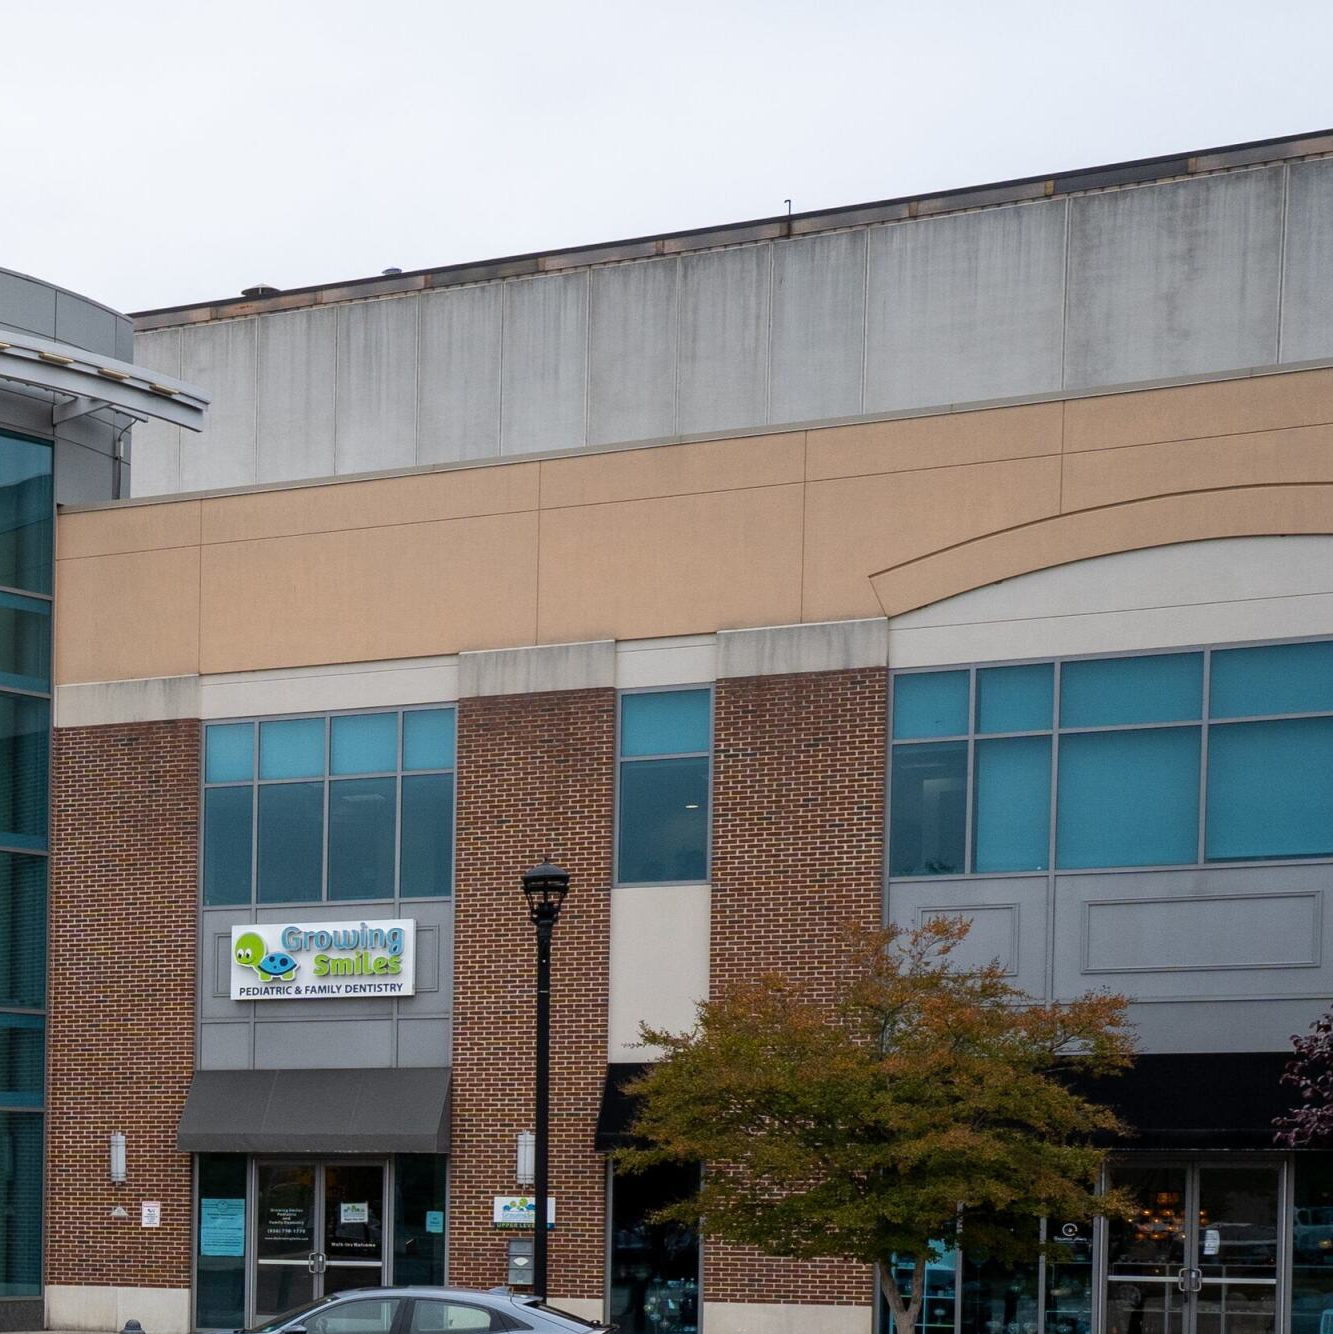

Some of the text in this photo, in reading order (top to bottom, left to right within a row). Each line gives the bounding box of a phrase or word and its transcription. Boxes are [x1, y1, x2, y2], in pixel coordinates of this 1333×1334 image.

[281, 922, 405, 957] Growing
[313, 951, 403, 977] Smiles
[239, 983, 404, 996] PEDIATRIC & FAMILY DENTISTRY
